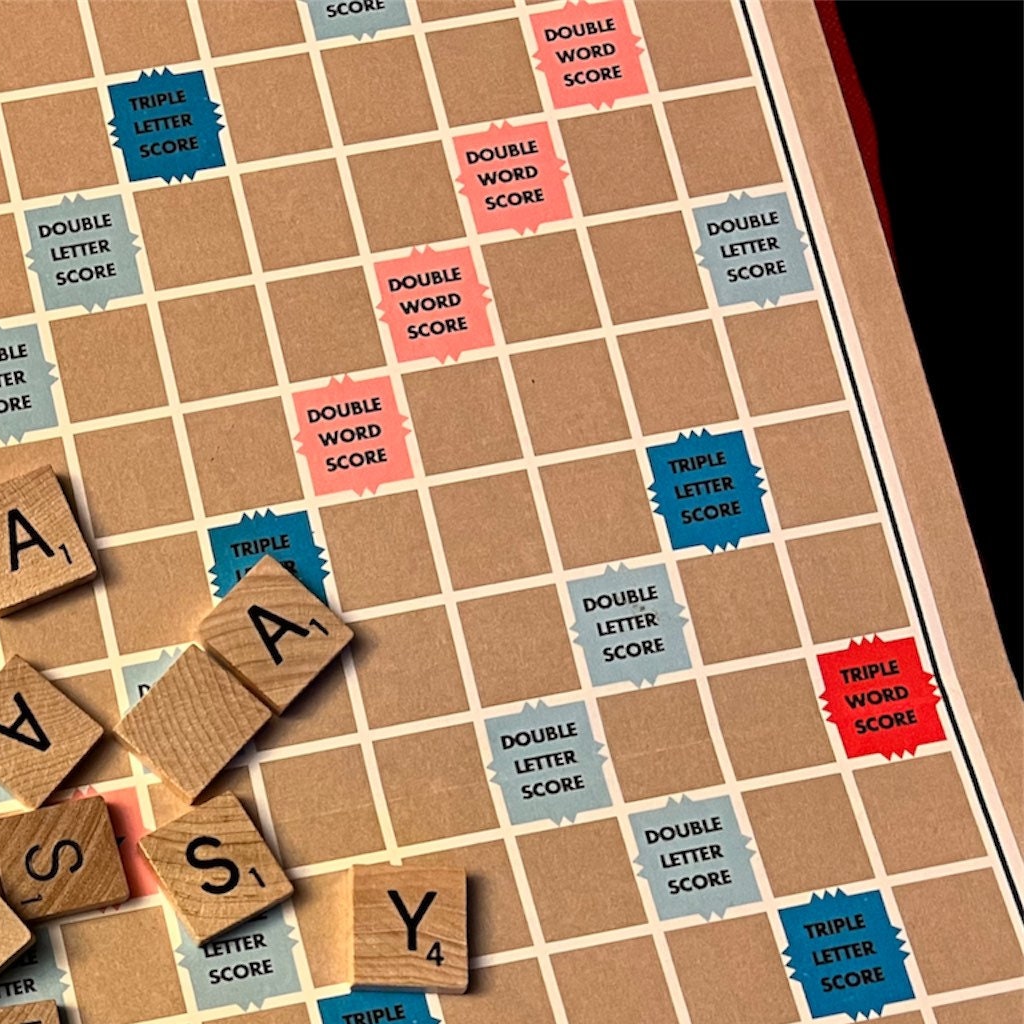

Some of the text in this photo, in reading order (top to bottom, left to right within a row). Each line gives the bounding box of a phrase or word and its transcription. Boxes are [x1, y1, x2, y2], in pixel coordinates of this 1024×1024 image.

[544, 18, 616, 42] DOUBLE
[555, 43, 616, 64] WORD
[563, 65, 622, 87] SCORE
[128, 89, 187, 111] TRIPLE
[134, 113, 193, 135] LETTER
[139, 136, 199, 158] SCORE
[706, 211, 780, 236] DOUBLE
[720, 237, 780, 259] LETTER
[727, 260, 787, 283] SCORE
[306, 397, 382, 424] DOUBLE
[318, 424, 382, 447] WORD
[326, 448, 388, 472] SCORE
[667, 451, 727, 474] TRIPLE
[674, 476, 735, 500] LETTER
[681, 500, 742, 525] SCORE
[229, 533, 291, 558] TRIPLE
[839, 659, 900, 684] TRIPLE
[844, 685, 909, 709] WORD
[854, 709, 918, 735] SCORE
[500, 722, 578, 750] DOUBLE
[514, 750, 578, 774] LETTER
[521, 775, 585, 800] SCORE
[803, 914, 866, 939] TRIPLE
[203, 932, 267, 958] LETTER
[812, 940, 877, 966] LETTER
[209, 959, 274, 985] SCORE
[820, 966, 885, 993] SCORE
